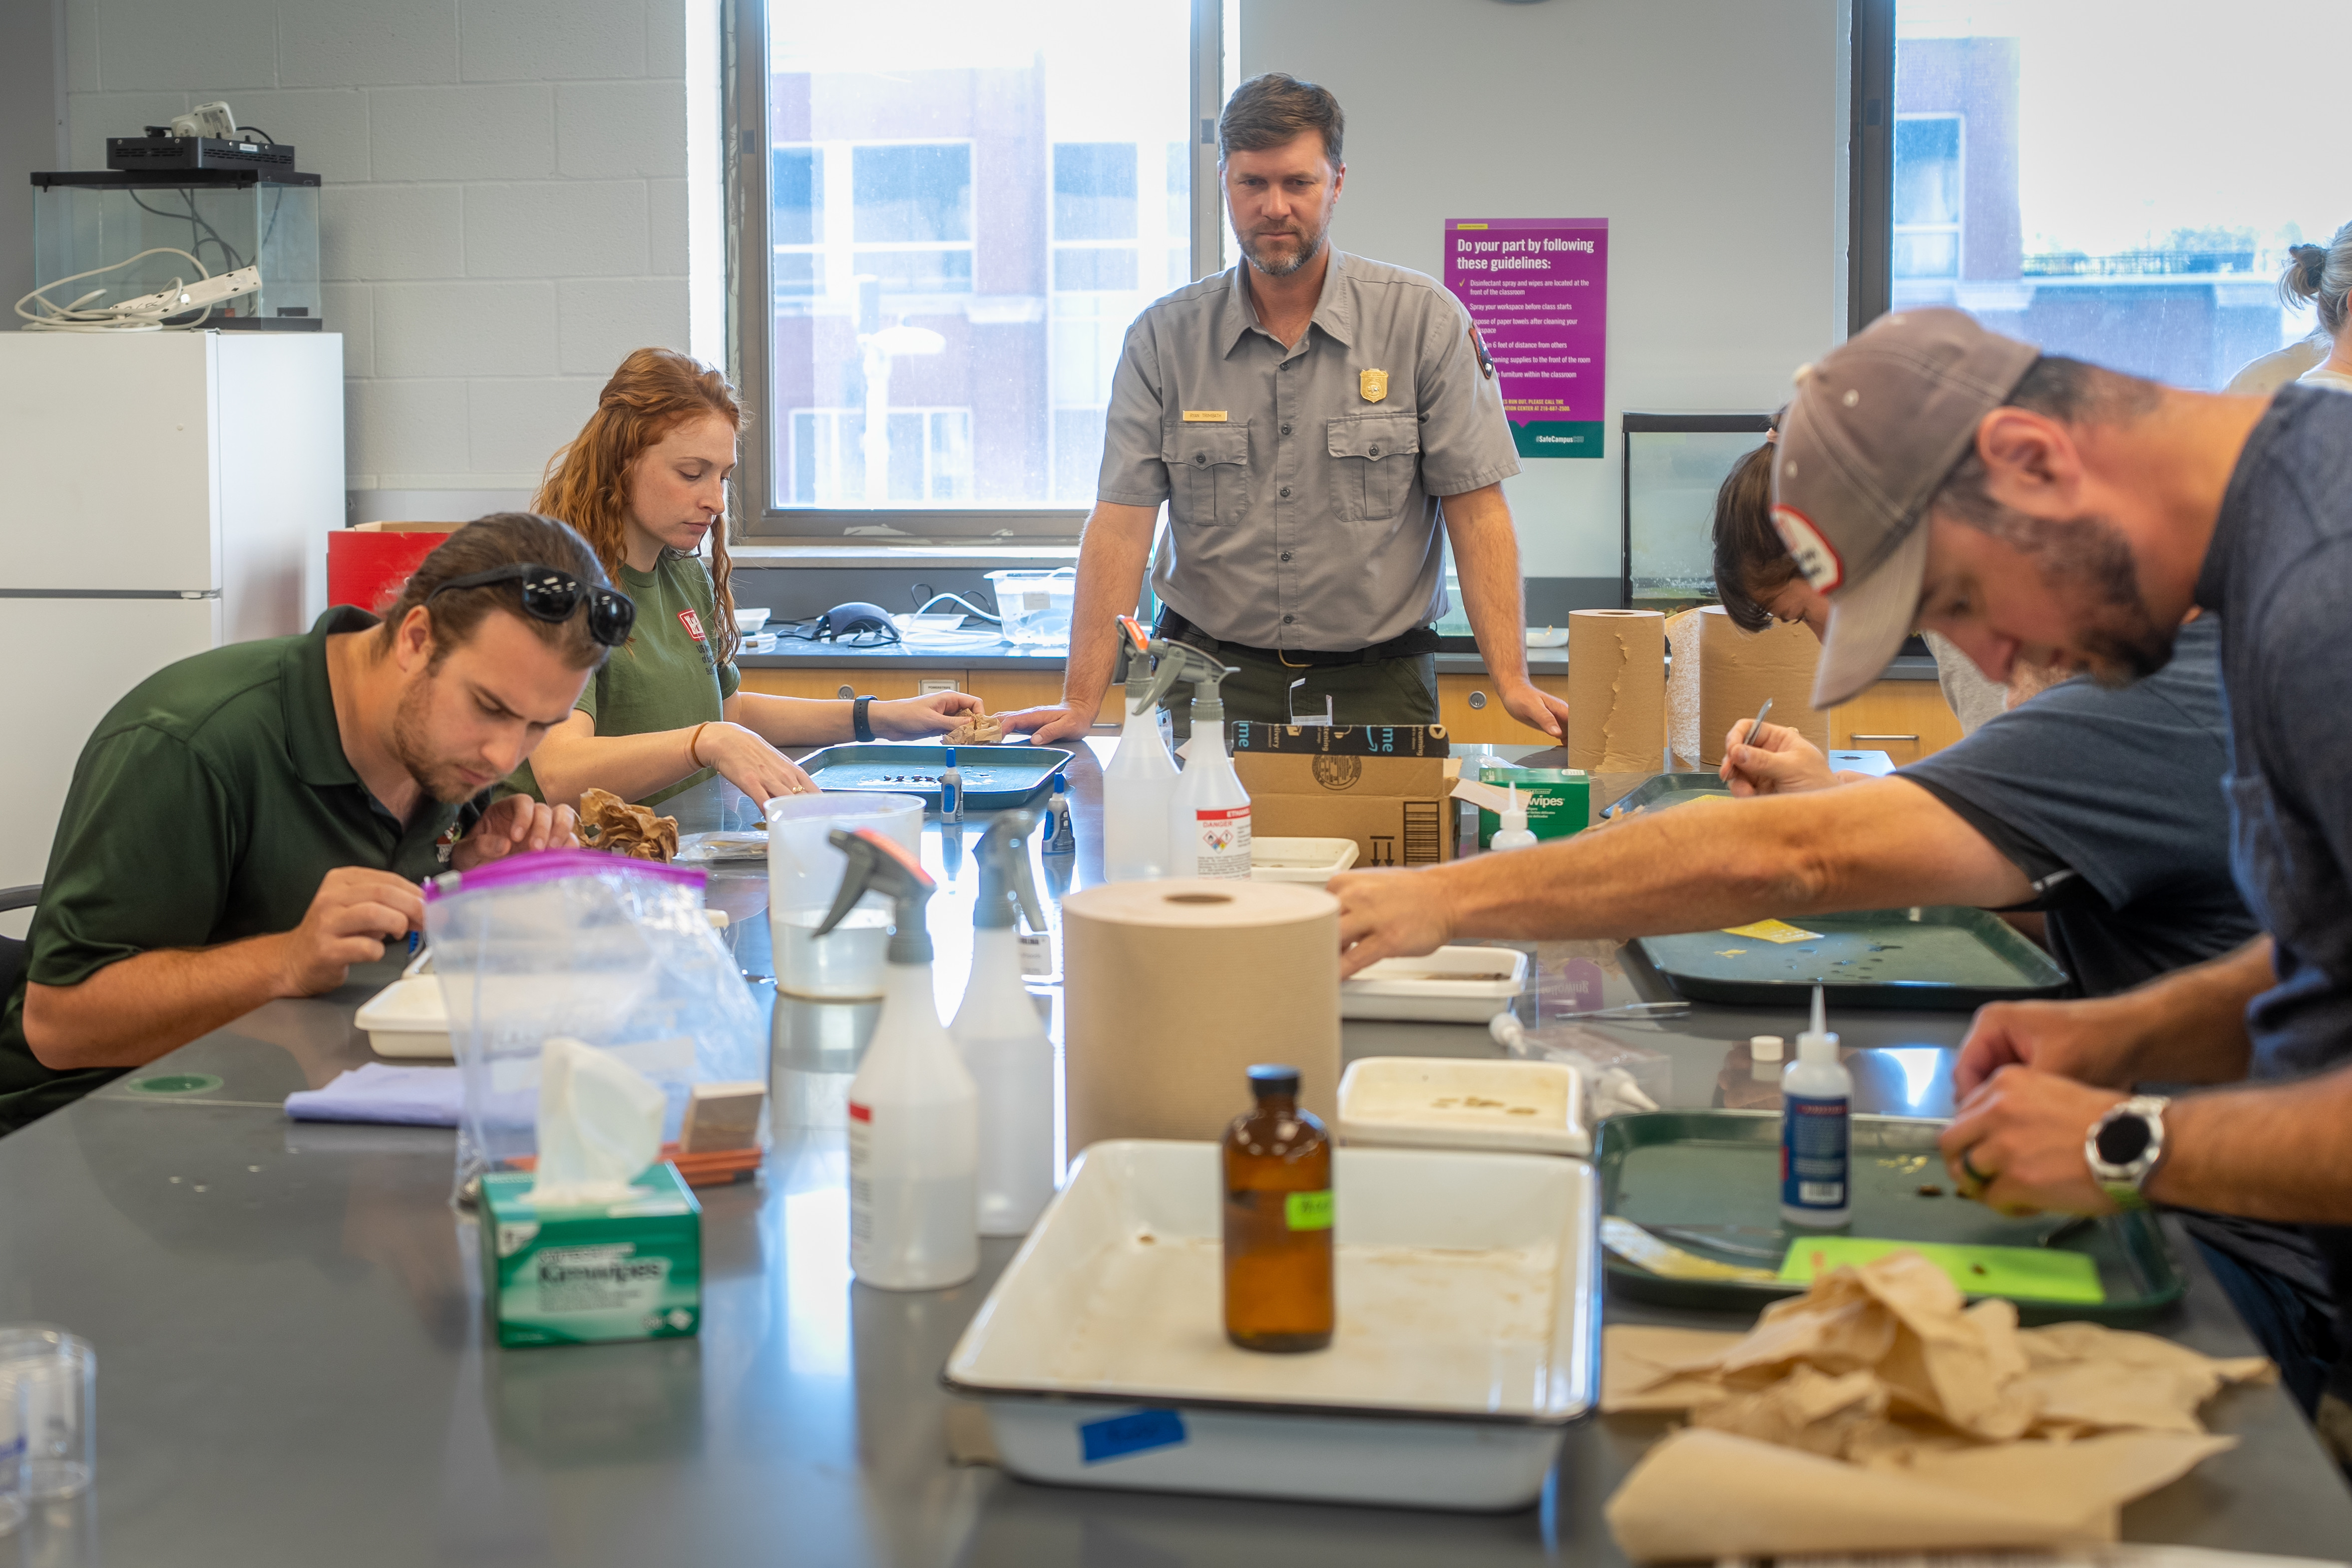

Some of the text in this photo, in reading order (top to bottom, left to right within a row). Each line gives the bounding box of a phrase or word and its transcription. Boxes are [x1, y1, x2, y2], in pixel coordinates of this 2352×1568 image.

[1457, 238, 1594, 254] Do your part by following
[1457, 256, 1551, 271] these guidelines:
[1272, 724, 1281, 749] elivery
[1382, 728, 1393, 753] me
[1416, 726, 1425, 756] treaming
[1529, 794, 1564, 808] wipes
